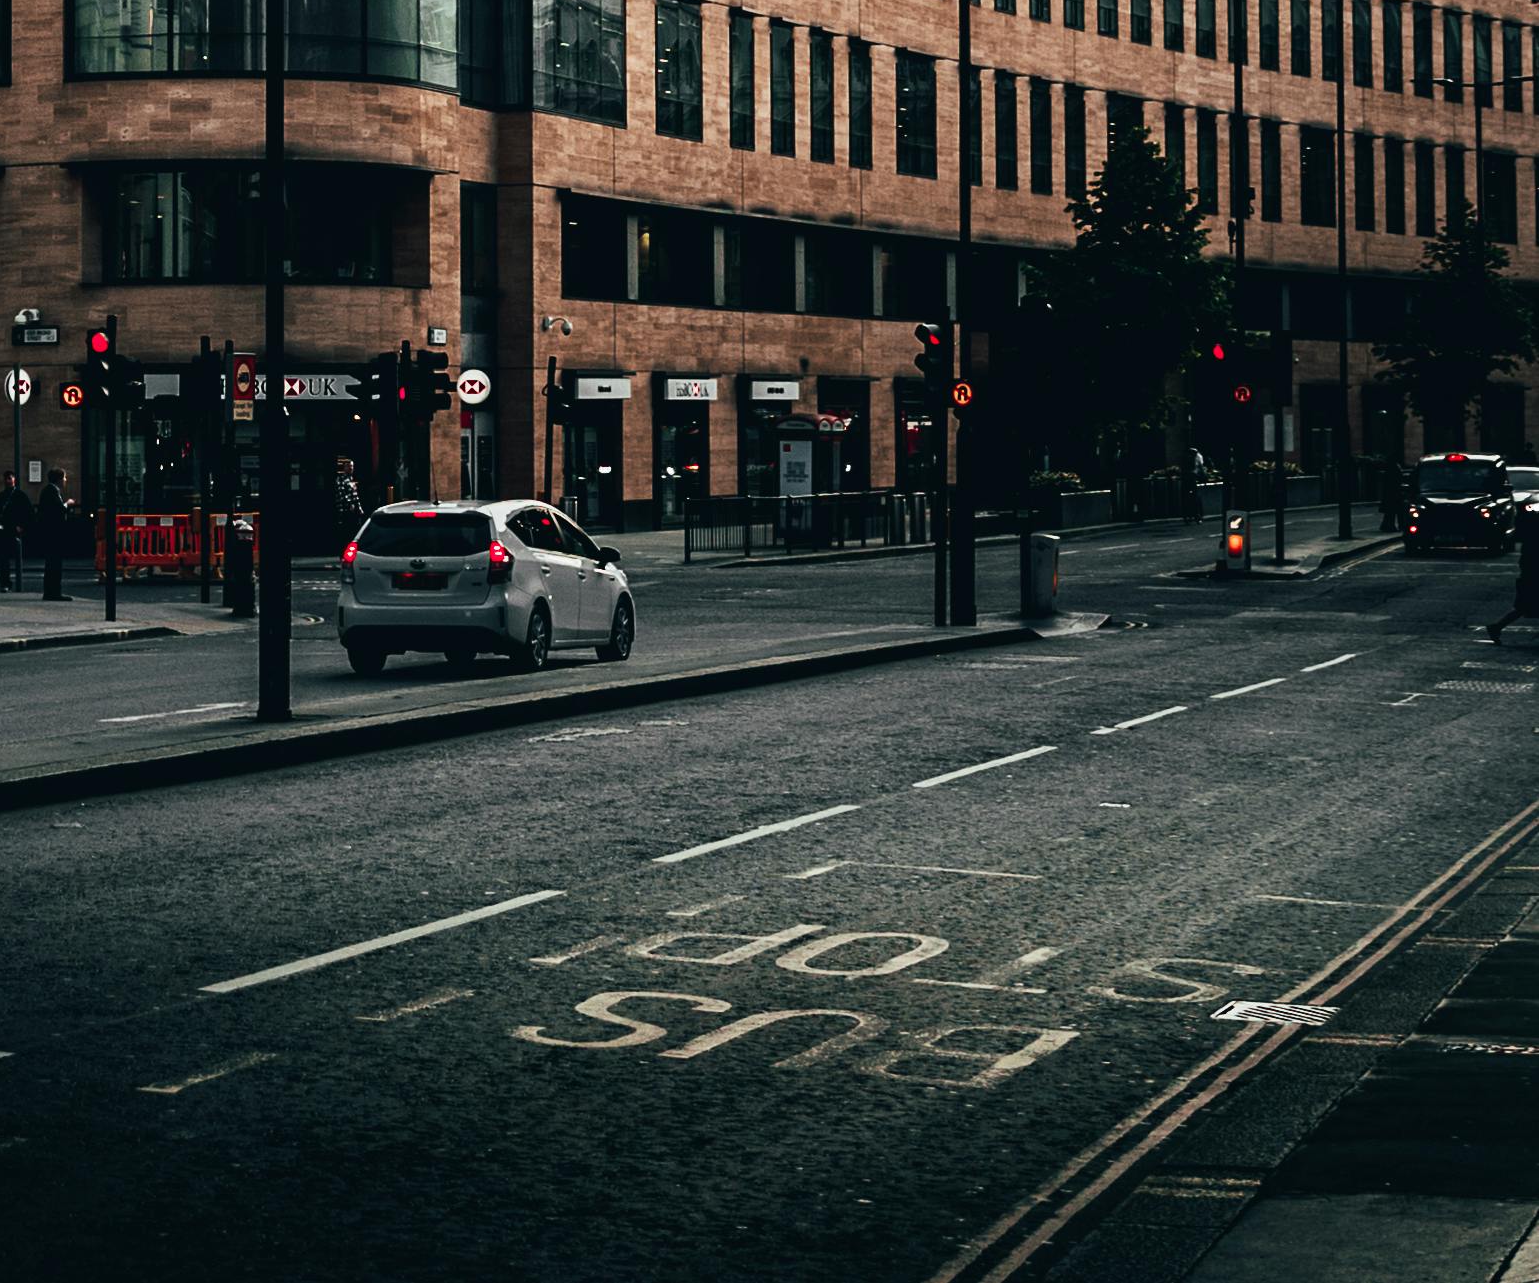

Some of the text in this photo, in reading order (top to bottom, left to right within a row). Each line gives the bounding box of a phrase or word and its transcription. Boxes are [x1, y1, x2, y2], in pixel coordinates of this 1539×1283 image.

[308, 378, 338, 396] UK
[620, 923, 1266, 1004] STOP
[509, 990, 1081, 1089] BUS
